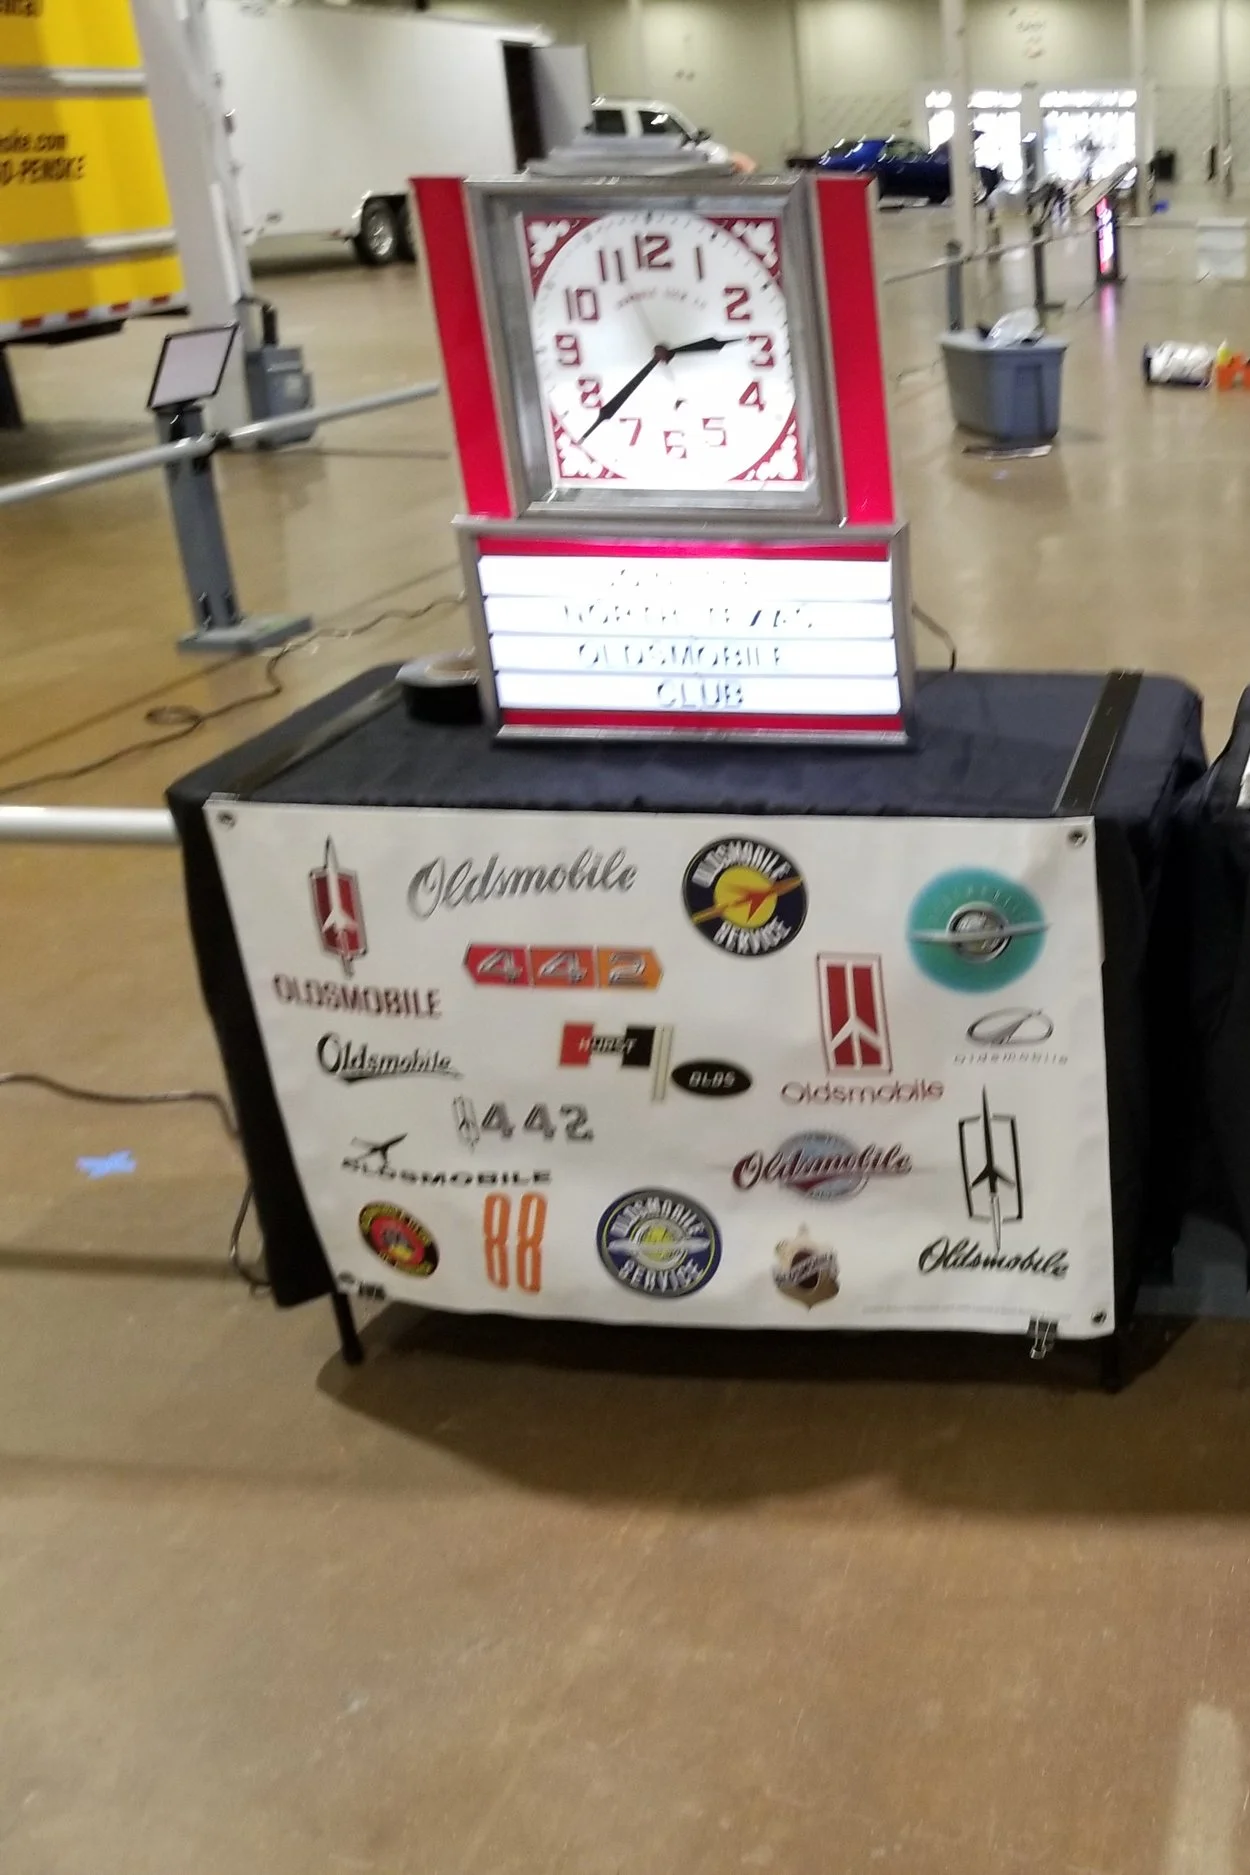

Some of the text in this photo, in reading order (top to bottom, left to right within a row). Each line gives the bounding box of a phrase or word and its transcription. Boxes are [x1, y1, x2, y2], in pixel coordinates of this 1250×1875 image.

[597, 249, 625, 282] 11
[634, 233, 672, 270] 12
[696, 247, 705, 280] 1
[565, 288, 600, 321] 10
[723, 286, 751, 321] 2
[554, 334, 581, 367] 9
[746, 334, 775, 367] 3
[577, 378, 603, 409] 8
[738, 381, 766, 413] 4
[618, 417, 642, 447] 7
[663, 430, 688, 460] 6
[702, 417, 728, 447] 5
[656, 680, 745, 708] CLUB
[407, 847, 638, 919] Oldsmobile
[273, 973, 442, 1019] OLDSMOBILE
[316, 1031, 462, 1083] Oldsmobile
[578, 1036, 638, 1055] HURST
[780, 1078, 945, 1106] Oldsmobile
[481, 1102, 595, 1143] 442
[732, 1142, 913, 1191] Oldsmobile
[483, 1192, 548, 1295] 88
[917, 1235, 1069, 1280] Oldsmobile
